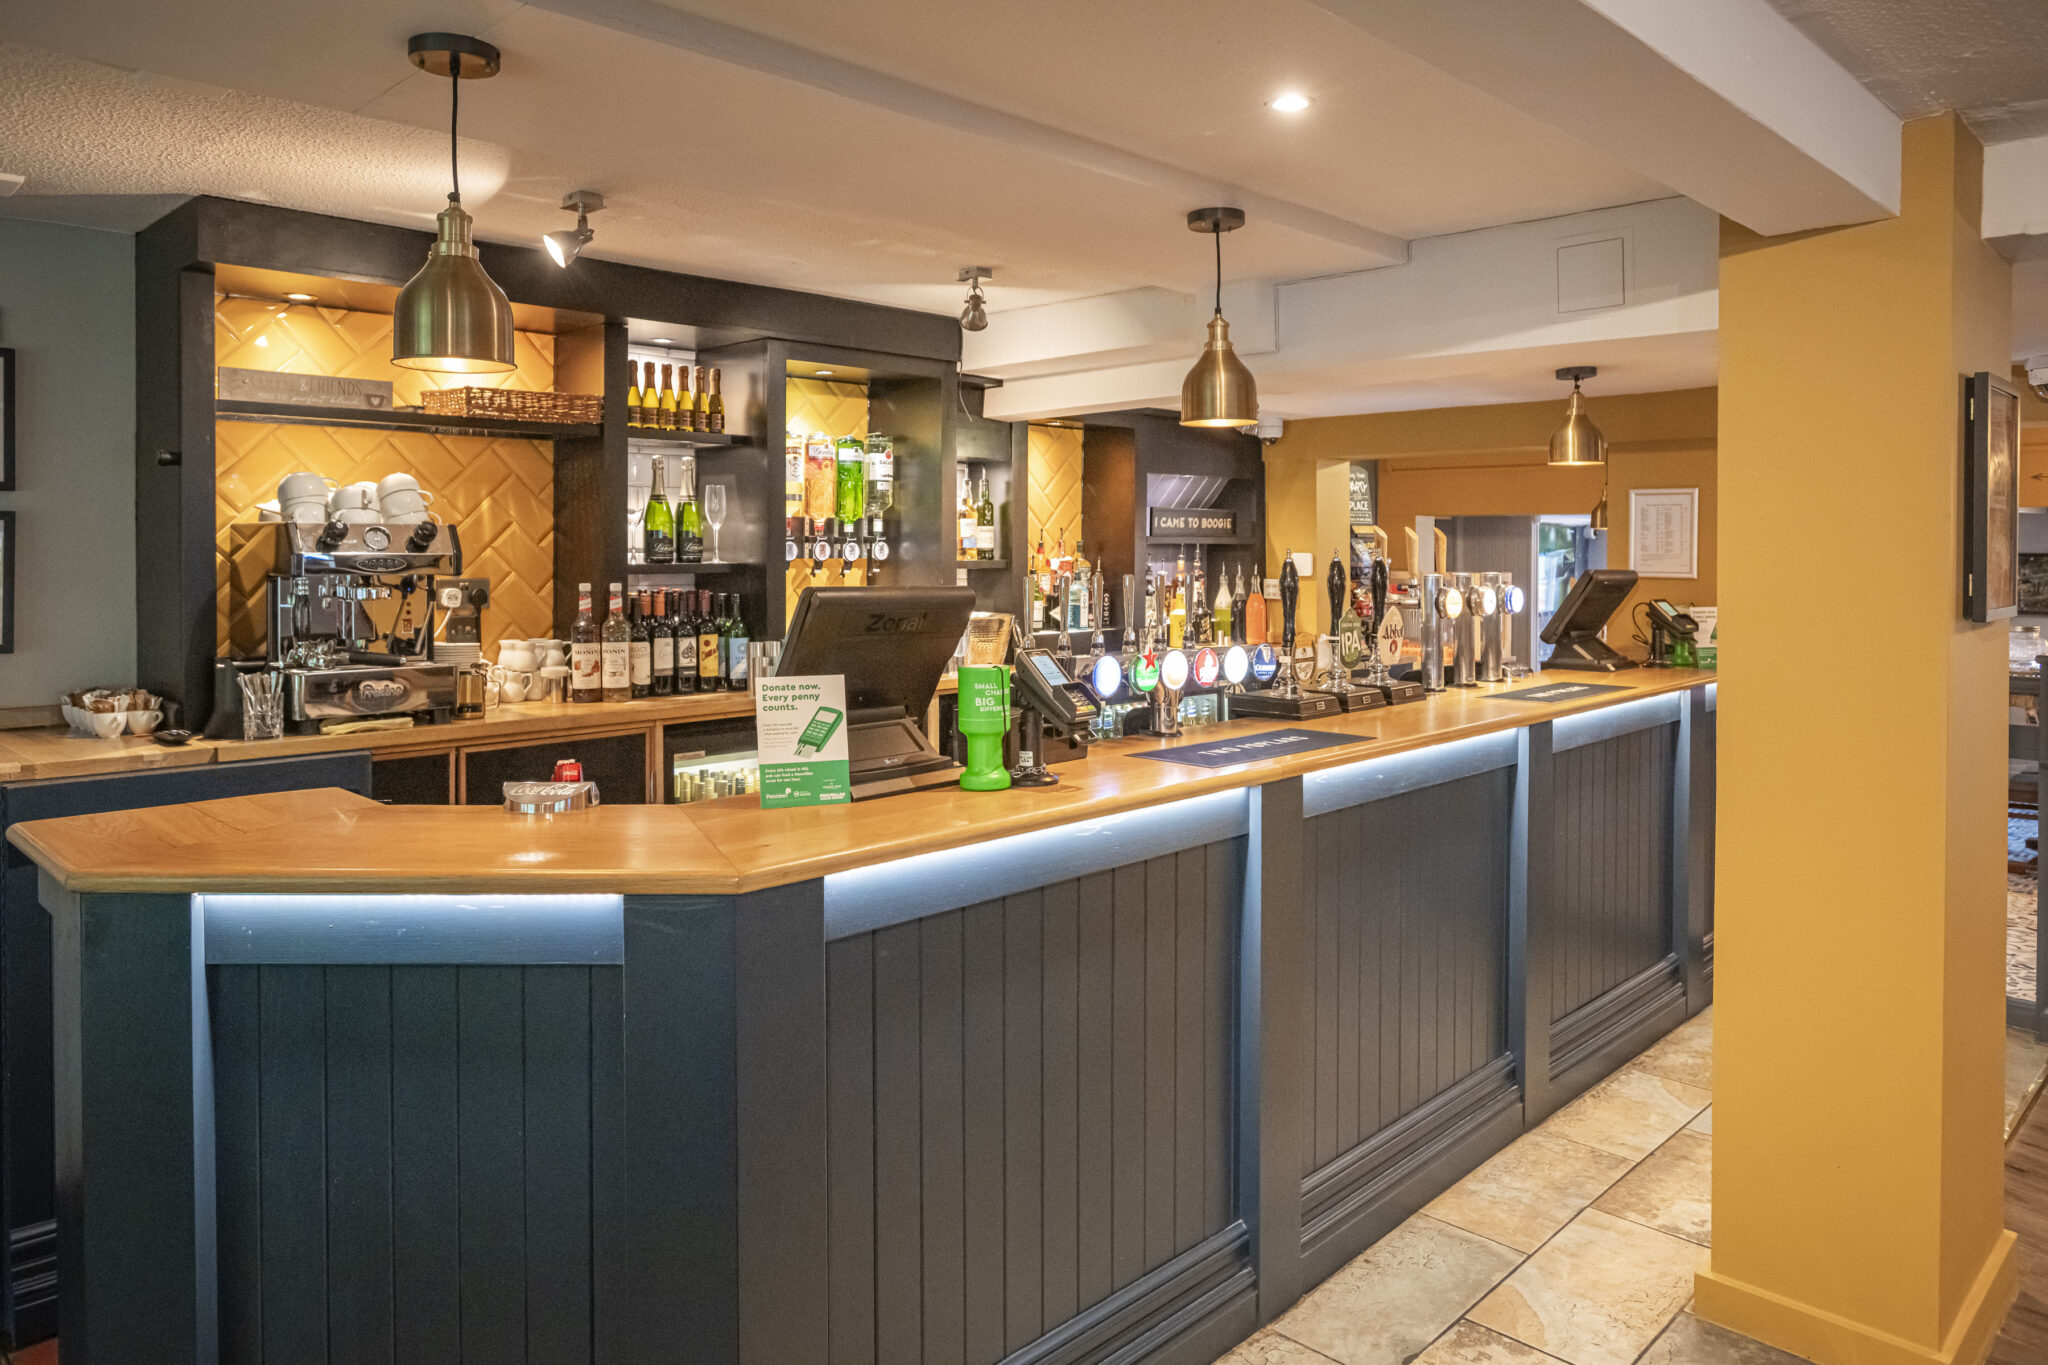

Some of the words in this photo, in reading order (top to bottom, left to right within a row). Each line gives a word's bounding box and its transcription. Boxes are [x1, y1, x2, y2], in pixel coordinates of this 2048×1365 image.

[310, 378, 362, 396] FRIENDS
[1350, 480, 1368, 493] ARTY
[1154, 516, 1158, 528] I
[1160, 516, 1185, 528] CAME
[1188, 517, 1200, 529] TO
[1201, 517, 1232, 529] BOOGIE
[865, 612, 928, 632] Zonal
[1341, 630, 1361, 656] IPA
[762, 683, 796, 692] Donate
[974, 682, 998, 690] SMALL
[762, 694, 788, 702] Every
[792, 693, 820, 702] penny
[975, 697, 995, 707] BIG
[762, 703, 798, 711] counts.
